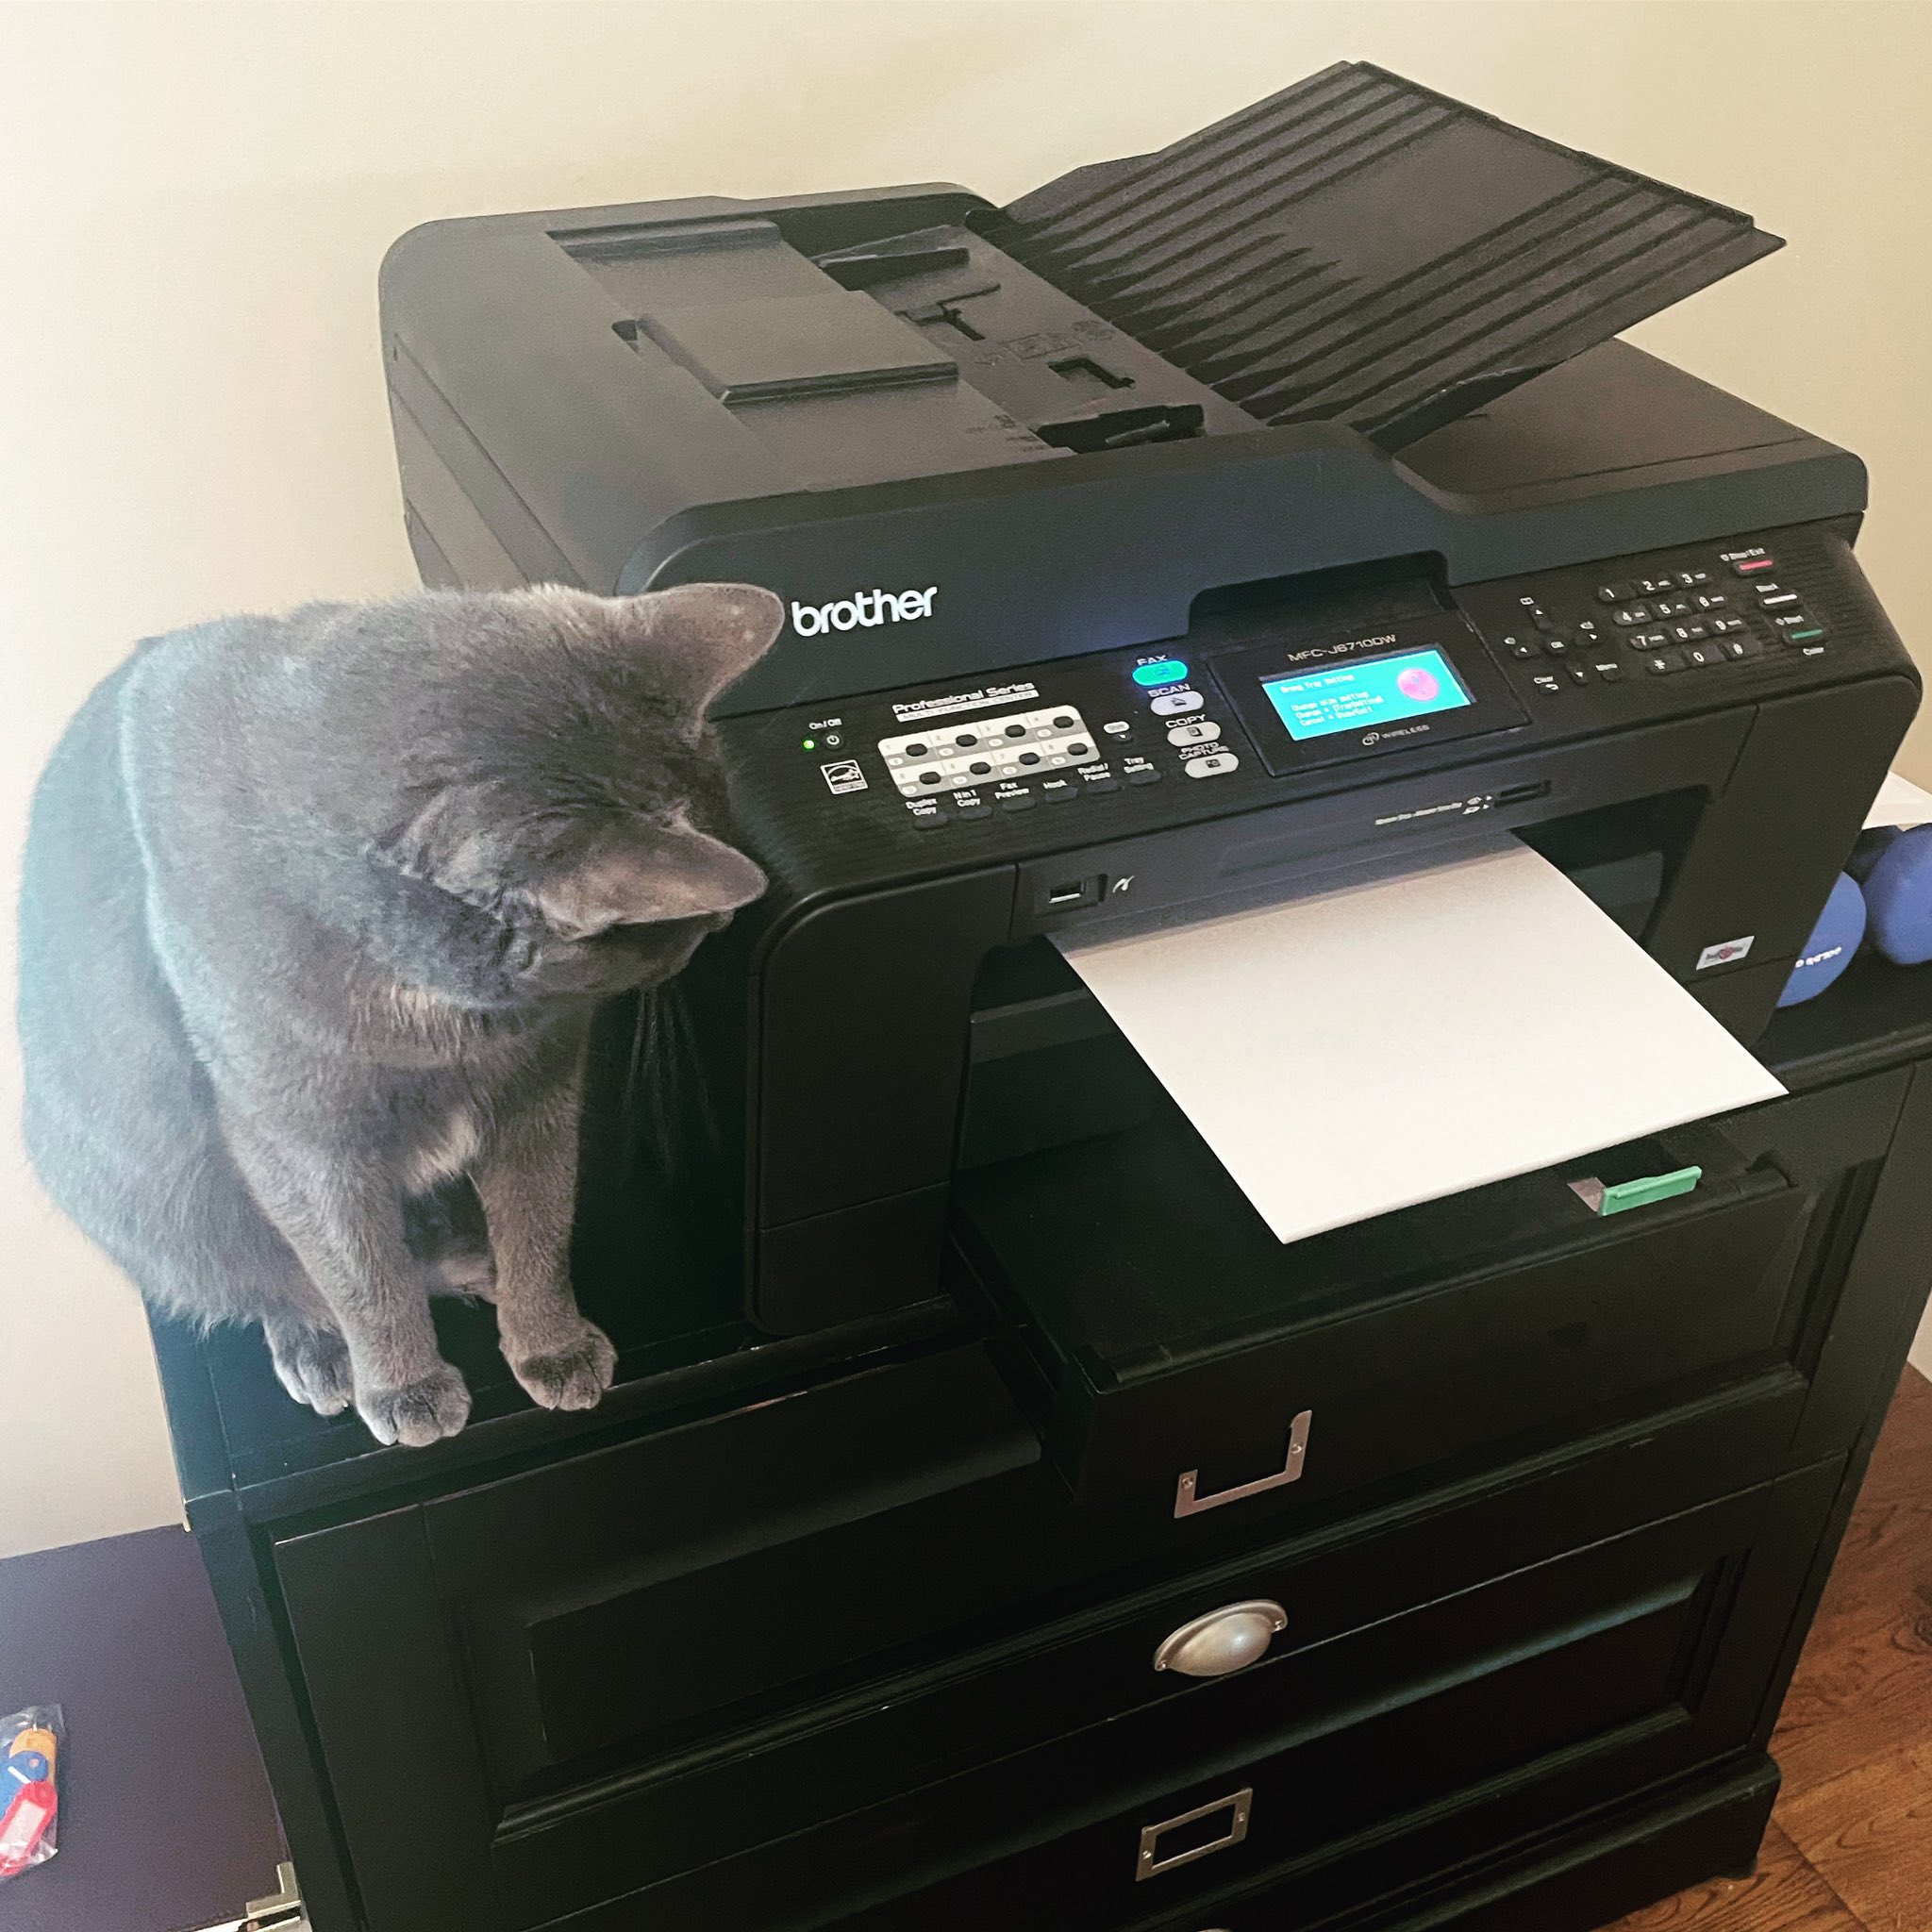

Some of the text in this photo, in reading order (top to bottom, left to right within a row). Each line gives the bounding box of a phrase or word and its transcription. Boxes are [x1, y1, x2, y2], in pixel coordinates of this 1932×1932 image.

[1682, 573, 1693, 584] 3
[1642, 580, 1656, 591] 2
[1606, 588, 1615, 598] 1
[1699, 596, 1710, 607] 6
[791, 586, 938, 637] brother
[1659, 604, 1672, 614] 5
[1715, 620, 1726, 631] 9
[1637, 635, 1647, 646] 7
[1137, 655, 1168, 666] FAX
[1693, 651, 1705, 662] 0
[1147, 683, 1191, 698] SCAN
[891, 682, 1036, 714] Professional Series
[1165, 714, 1206, 728] COPY
[1178, 745, 1230, 760] CAPTURE
[1180, 741, 1220, 754] PHOTO
[1000, 782, 1019, 791] Fax
